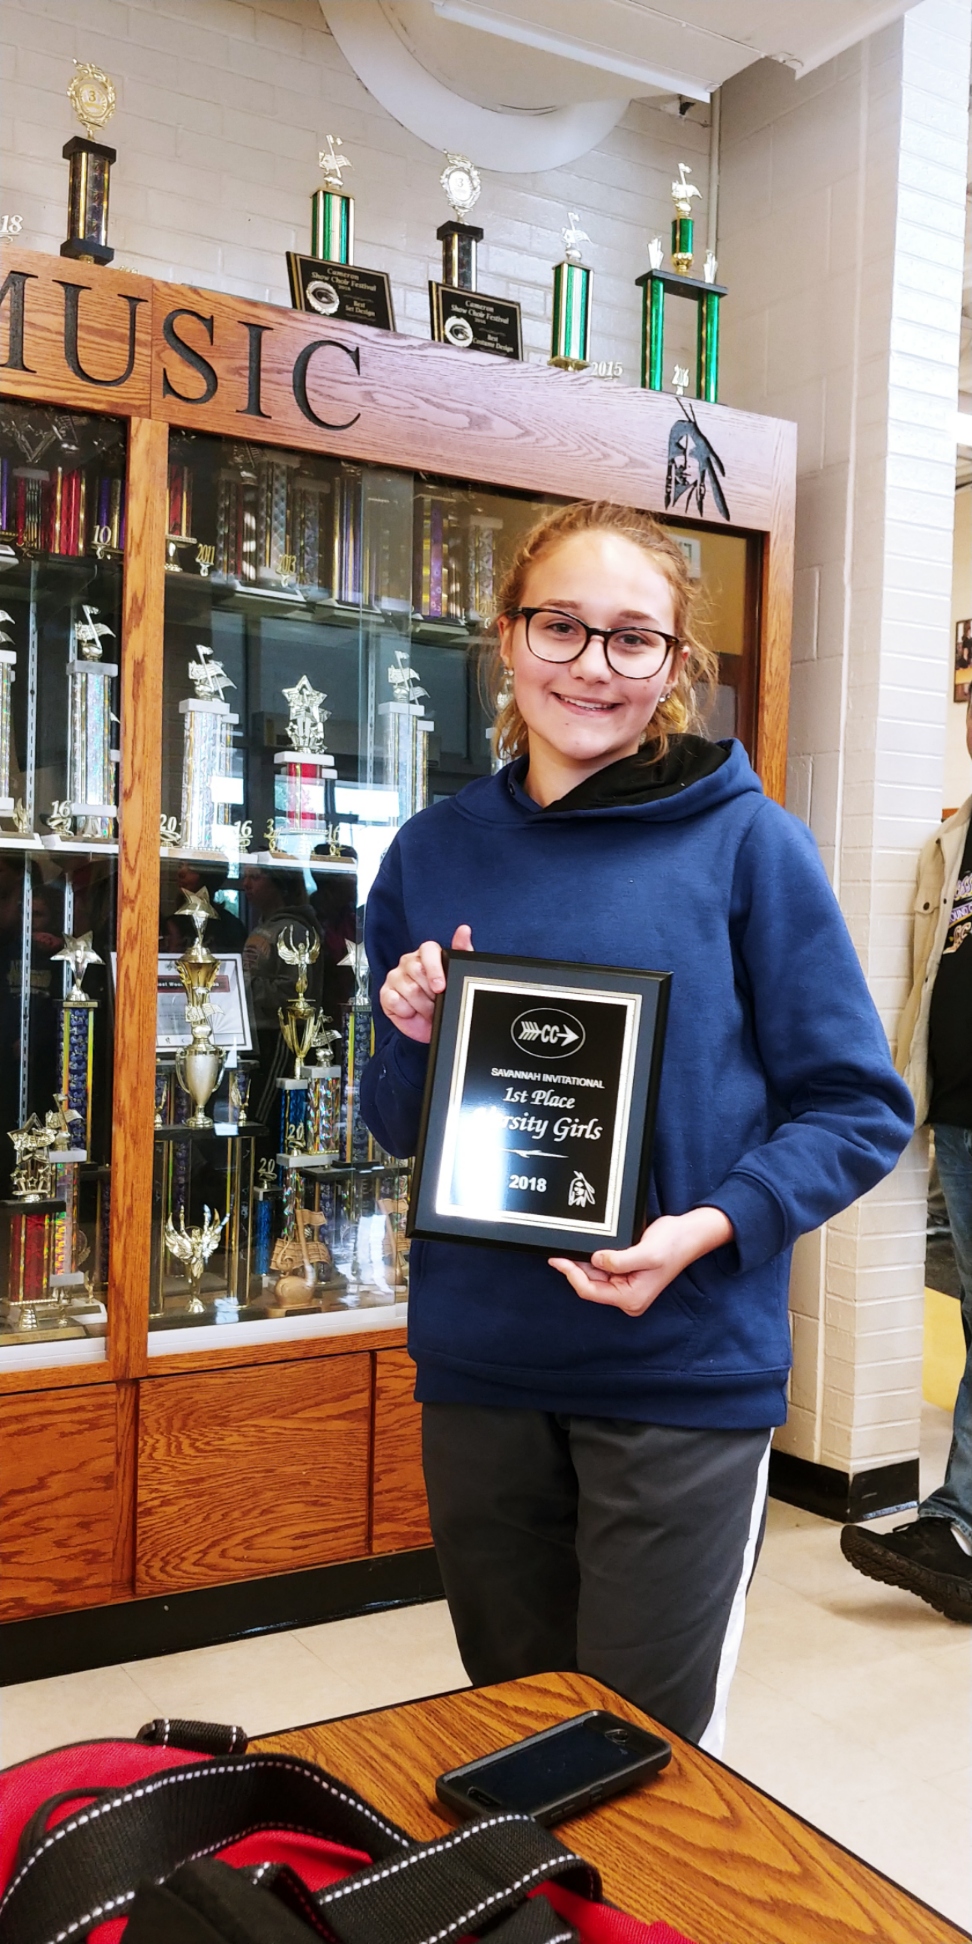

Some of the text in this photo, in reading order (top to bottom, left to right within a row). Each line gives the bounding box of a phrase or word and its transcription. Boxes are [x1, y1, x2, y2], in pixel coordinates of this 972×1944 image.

[311, 271, 377, 292] Show Choir Festival
[327, 268, 359, 280] Cameron
[353, 300, 366, 308] Best
[355, 307, 376, 317] Design
[465, 300, 495, 312] Cameron
[451, 304, 509, 324] Show Choir Festival
[472, 337, 514, 353] Costume Design
[487, 334, 499, 342] Best
[591, 361, 623, 377] 2015
[93, 525, 111, 545] 10
[196, 543, 215, 566] 2011
[276, 553, 297, 575] 2013
[51, 800, 71, 818] 16
[234, 820, 253, 838] 16
[541, 1024, 559, 1043] CC
[491, 1067, 605, 1089] SAVANNAH INVITATIONAL
[503, 1087, 575, 1109] 1st Place
[474, 1106, 603, 1142] rsity Girls
[258, 1157, 275, 1173] 20
[509, 1175, 547, 1192] 2018
